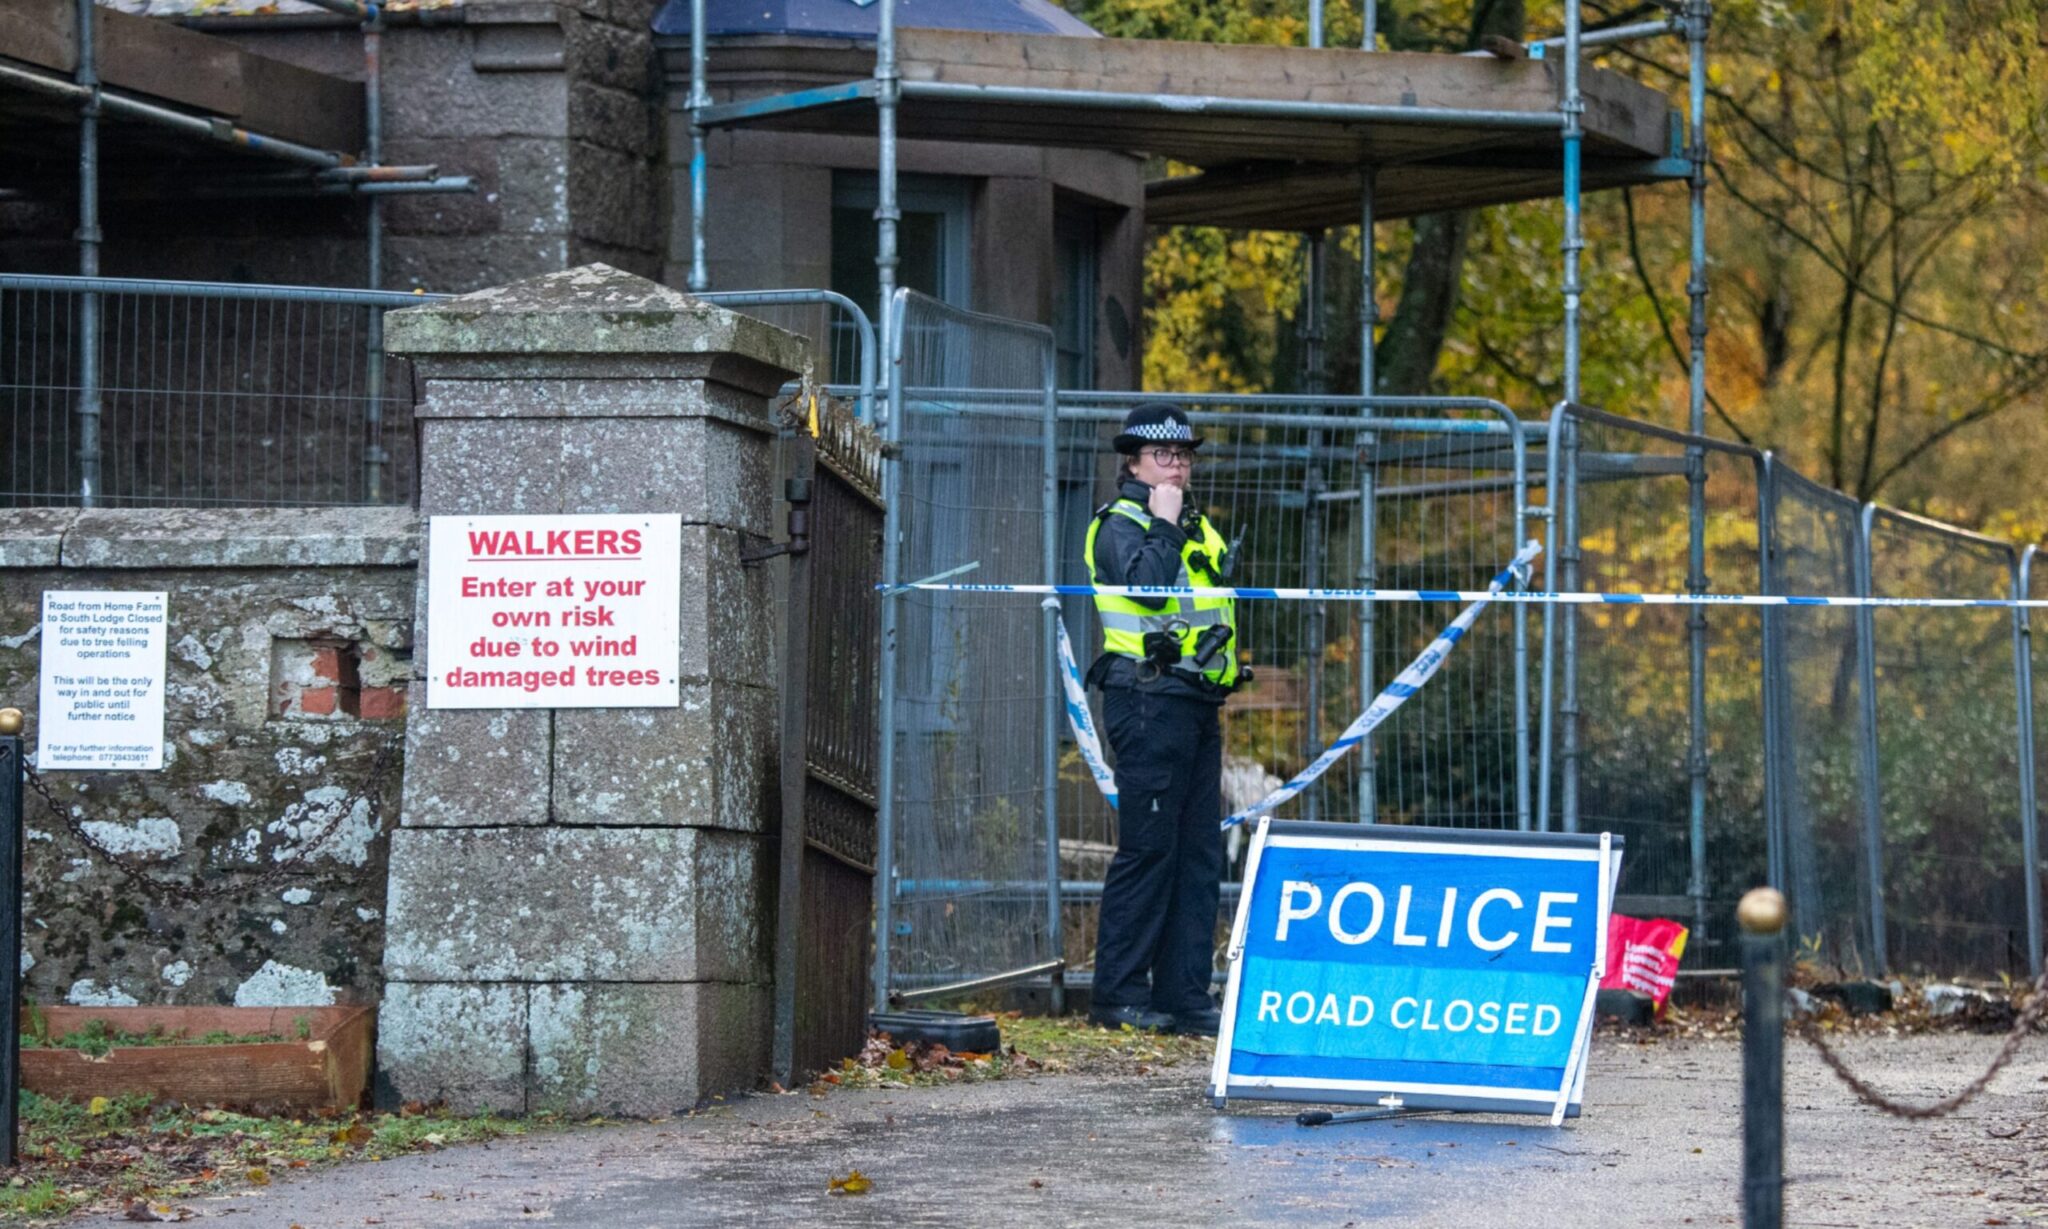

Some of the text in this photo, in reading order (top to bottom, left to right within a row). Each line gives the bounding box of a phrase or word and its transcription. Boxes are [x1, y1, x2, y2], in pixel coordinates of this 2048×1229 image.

[468, 529, 642, 556] WALKERS
[461, 577, 646, 601] Enter at your
[49, 602, 162, 611] Road from Home Farm
[48, 614, 162, 625] to South Lodge Closed
[492, 606, 614, 627] own risk
[60, 626, 149, 636] for safety reasons
[60, 638, 148, 648] due to tree felling
[469, 635, 637, 657] due to wind
[77, 650, 130, 660] operations
[53, 676, 152, 687] This will be the only
[446, 666, 660, 692] damaged trees
[57, 689, 147, 698] way in and out for
[74, 700, 130, 710] public until
[68, 712, 135, 721] further notice
[64, 745, 77, 753] any
[1274, 880, 1579, 954] POLICE
[1257, 990, 1561, 1037] ROAD CLOSED
